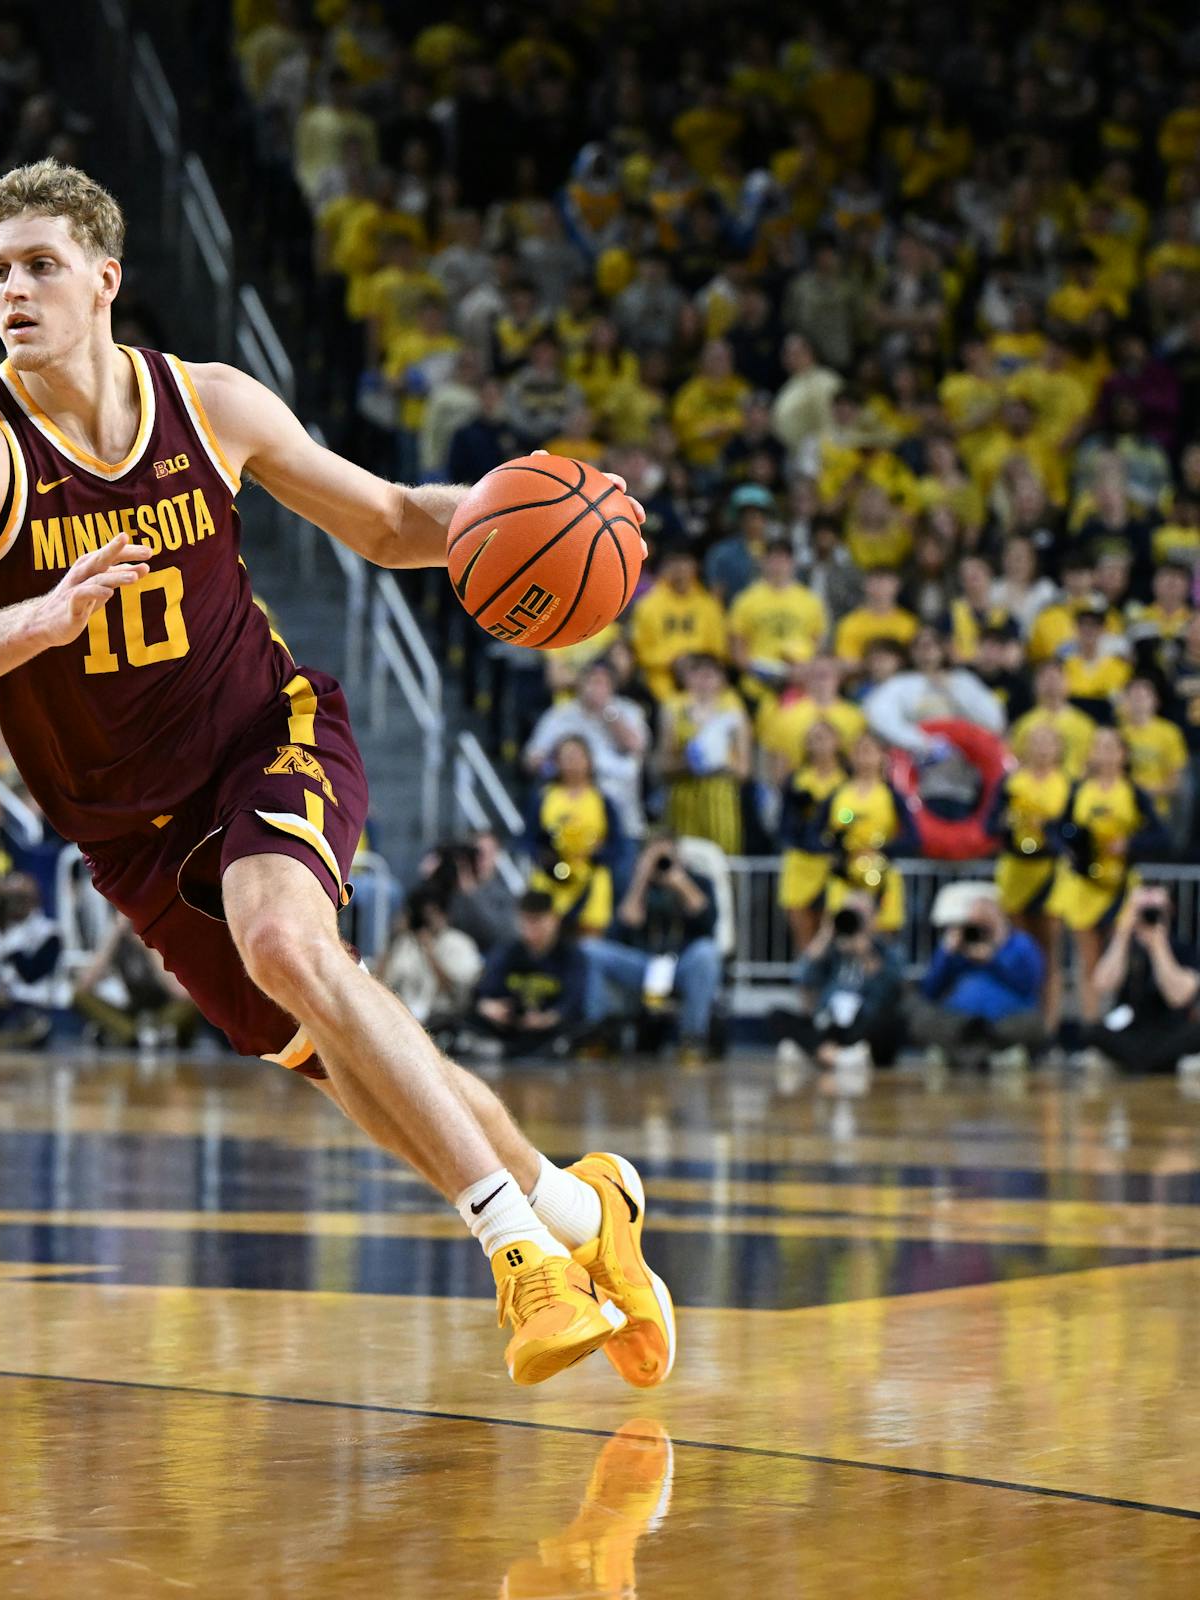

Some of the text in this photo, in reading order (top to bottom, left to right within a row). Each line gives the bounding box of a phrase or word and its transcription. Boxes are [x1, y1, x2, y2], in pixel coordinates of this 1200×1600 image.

[31, 487, 216, 571] MINNESOTA
[84, 565, 191, 675] 10
[487, 582, 556, 641] ELITE
